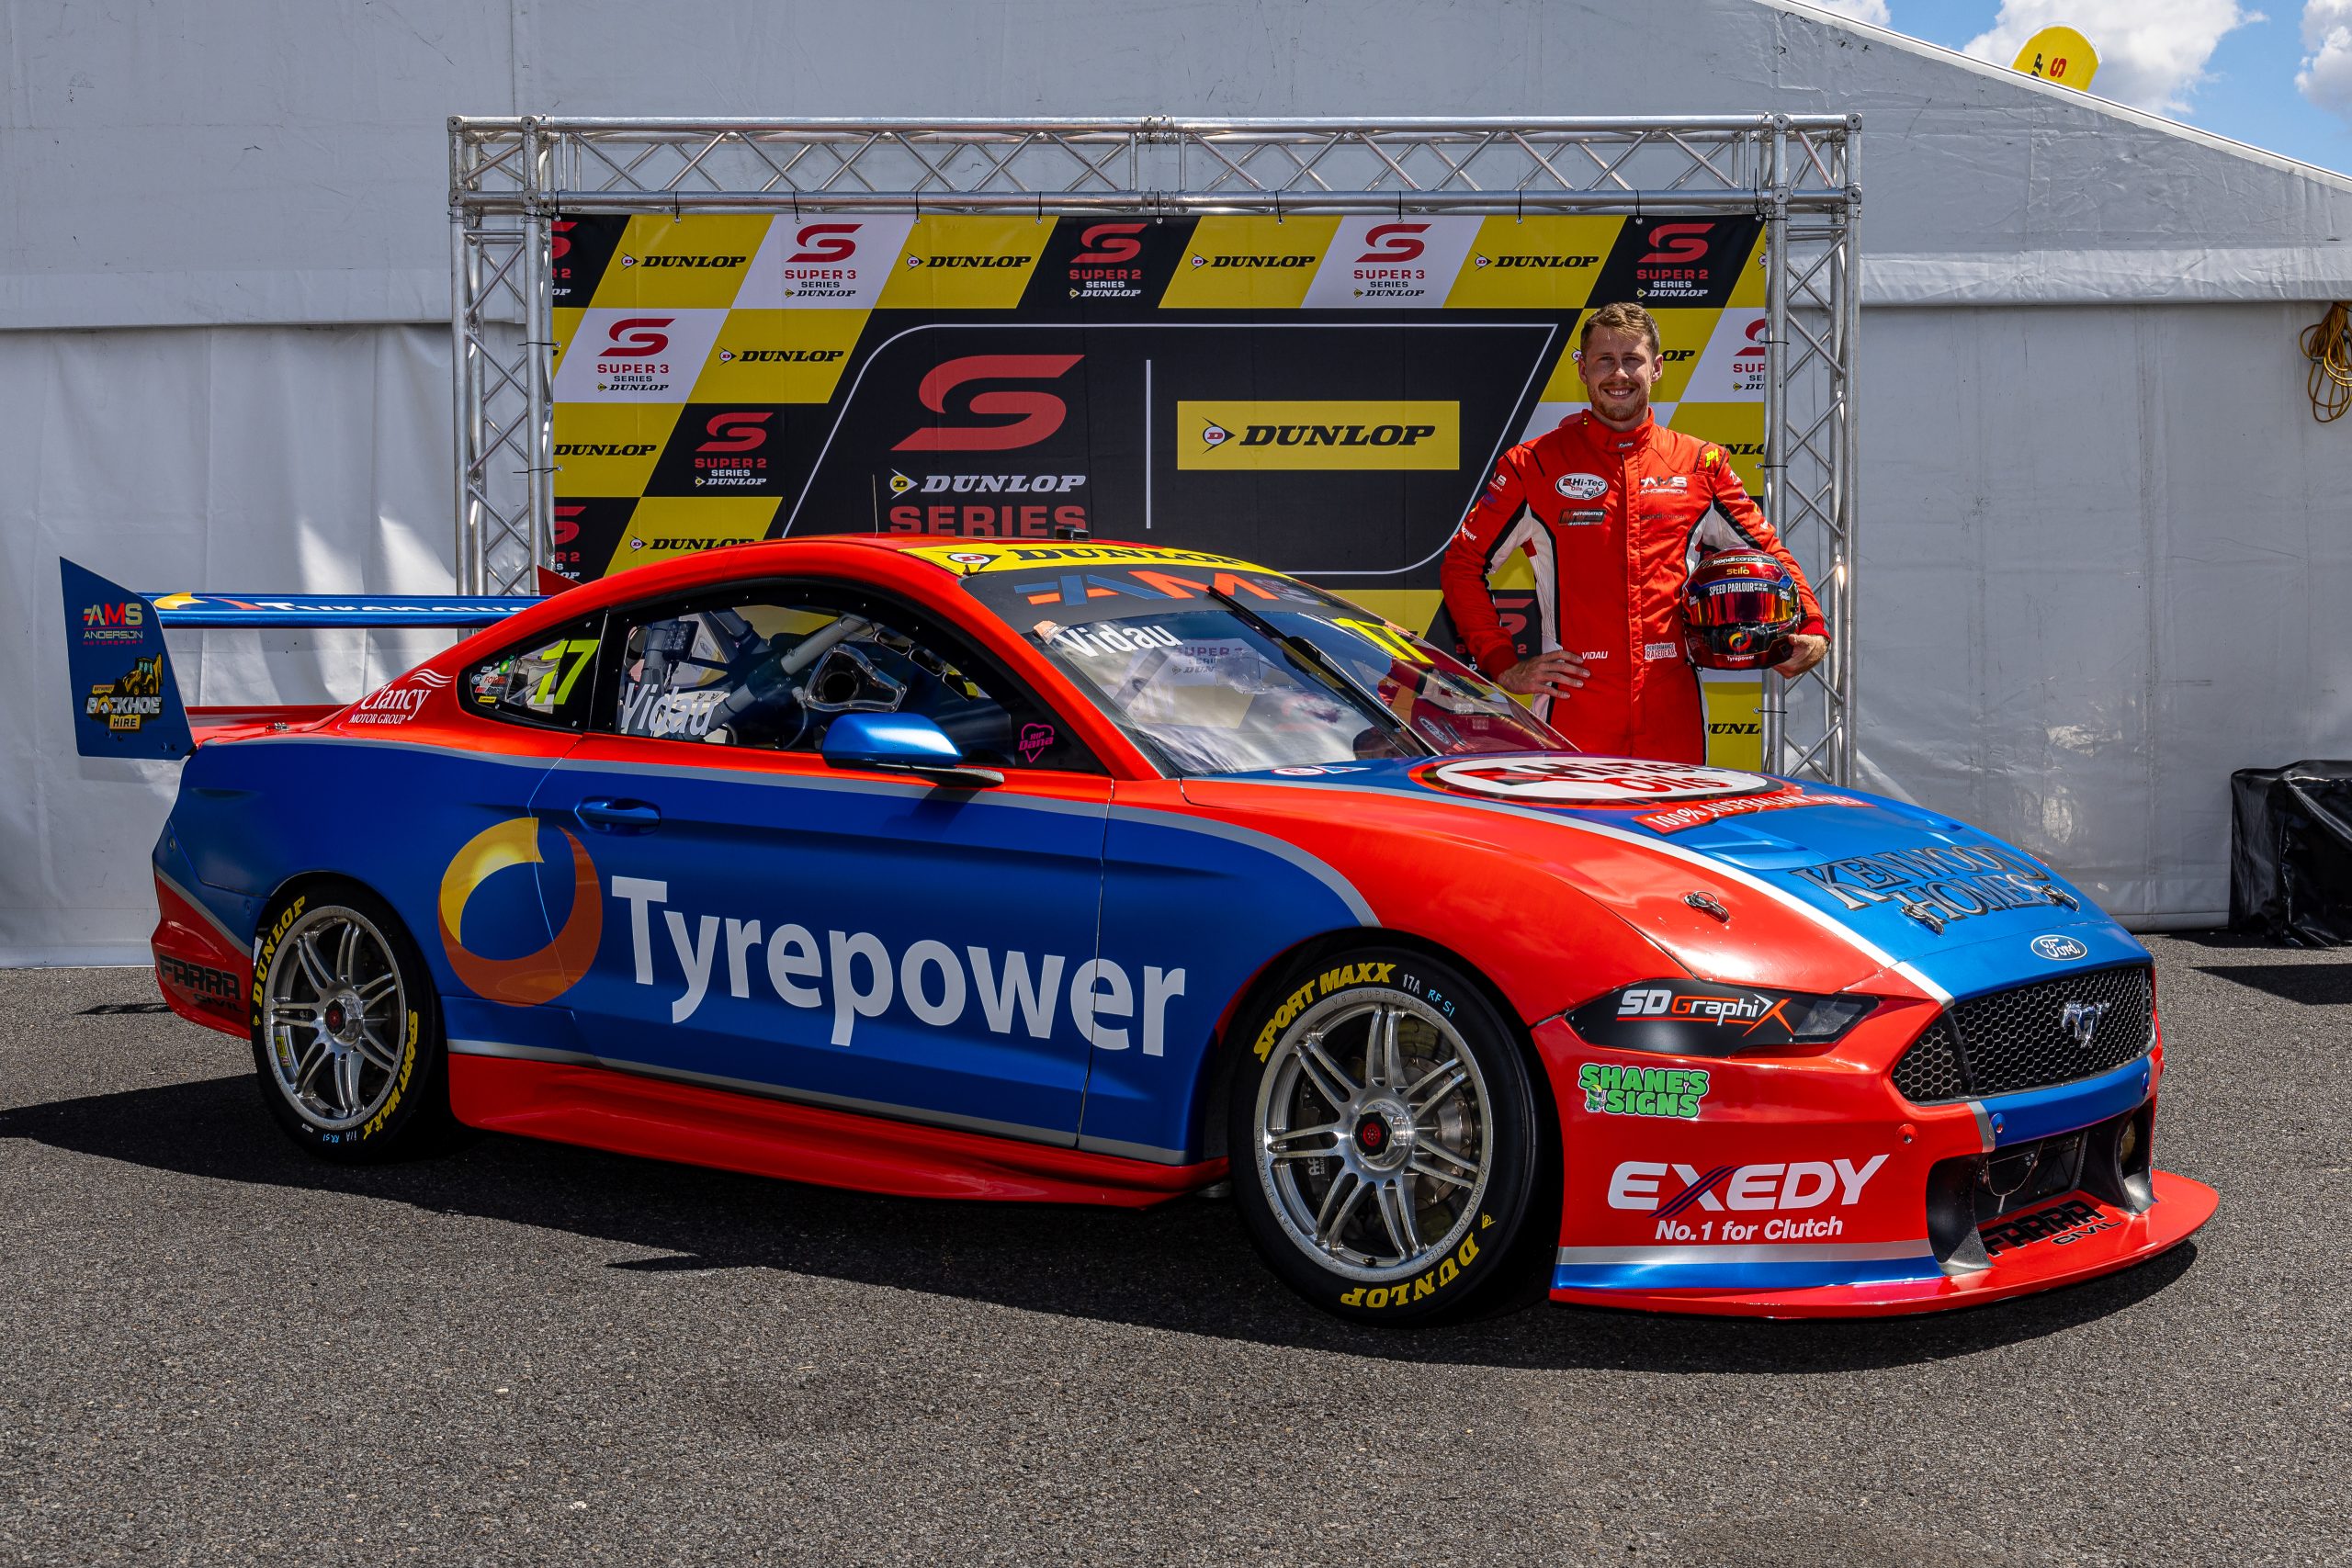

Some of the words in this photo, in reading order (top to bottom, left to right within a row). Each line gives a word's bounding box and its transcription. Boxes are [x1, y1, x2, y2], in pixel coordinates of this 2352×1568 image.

[641, 255, 747, 268] DUNLOP
[926, 255, 1032, 268] DUNLOP
[1210, 255, 1316, 268] DUNLOP
[1494, 255, 1600, 268] DUNLOP
[785, 270, 842, 279] SUPER
[847, 270, 856, 279] 3
[1069, 269, 1128, 279] SUPER
[1132, 269, 1141, 279] 2
[1353, 270, 1412, 279] SUPER
[1416, 270, 1425, 279] 3
[1637, 269, 1695, 279] SUPER
[1699, 269, 1709, 279] 2
[739, 350, 844, 361] DUNLOP
[597, 364, 656, 374] SUPER
[660, 364, 669, 374] 3
[1238, 424, 1436, 446] DUNLOP
[553, 444, 657, 457] DUNLOP
[695, 458, 753, 468] SUPER
[757, 458, 766, 468] 2
[920, 475, 1087, 492] DUNLOP
[1572, 478, 1604, 487] Hi-Tec
[889, 505, 1087, 536] SERIES
[1006, 547, 1246, 566] DUNLOP
[1726, 566, 1750, 575] stilo
[1709, 584, 1726, 596] SPEED
[1728, 582, 1755, 593] PARLOUR
[83, 603, 143, 626] AMS
[84, 630, 143, 639] ANDERSON
[1054, 625, 1183, 658] Vidau
[1581, 650, 1608, 660] VIDAU
[1646, 649, 1676, 659] RACEGEAR
[534, 638, 600, 705] 17
[360, 682, 432, 721] Clancy
[621, 682, 716, 736] Vidau
[112, 717, 137, 728] HIRE
[348, 713, 379, 724] MOTOR
[378, 714, 407, 724] GROUP
[1019, 737, 1054, 751] Dana
[1030, 732, 1045, 740] RIP
[1647, 805, 1708, 828] 100%
[1788, 843, 2051, 912] KENWOOD
[1884, 872, 2052, 924] HOMES
[253, 895, 306, 1008] DUNLOP
[2040, 938, 2081, 958] Ford
[611, 875, 1186, 1058] Tyrepower
[159, 954, 241, 1001] FARRA
[1428, 988, 1442, 1003] RF
[1616, 989, 1672, 1016] SD
[1253, 978, 1316, 1063] SPORT
[1319, 962, 1397, 996] MAXX
[1579, 1065, 1710, 1096] SHANE'S
[1606, 1089, 1701, 1118] SIGNS
[1607, 1154, 1891, 1213] EXEDY
[1722, 1220, 1758, 1240] for
[1764, 1215, 1843, 1240] Clutch
[2051, 1219, 2122, 1246] CIVIL
[1340, 1232, 1480, 1309] DUNLOP
